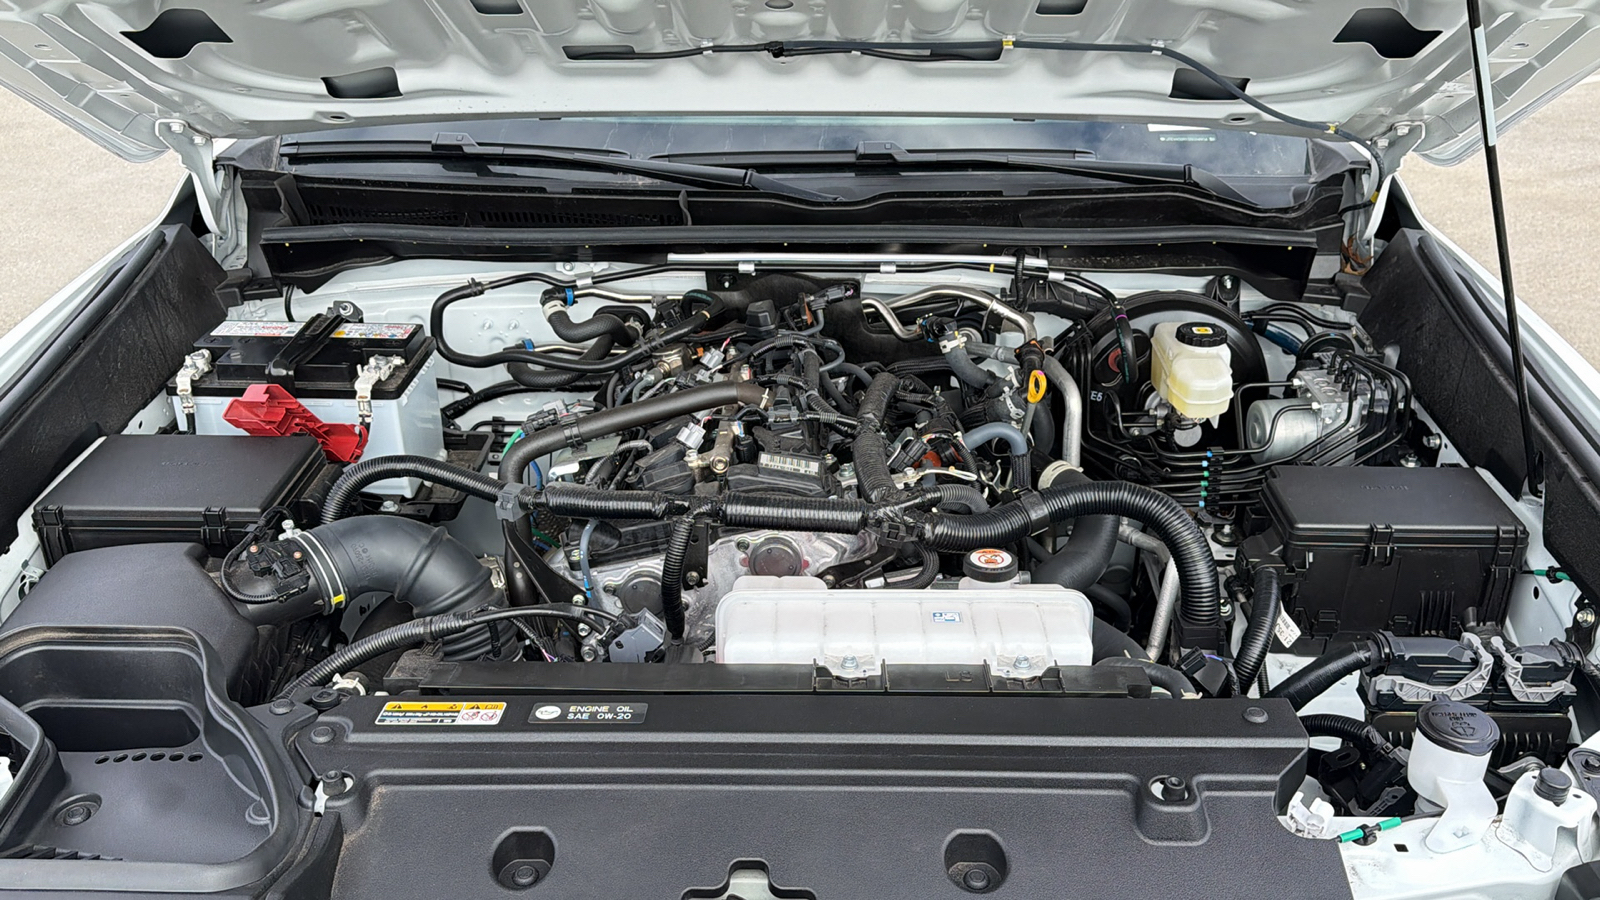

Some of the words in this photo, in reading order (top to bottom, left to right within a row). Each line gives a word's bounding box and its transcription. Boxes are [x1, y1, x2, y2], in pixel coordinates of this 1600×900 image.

[569, 705, 610, 713] ENGINE
[616, 705, 634, 713] OIL
[566, 712, 591, 720] SAE
[596, 712, 632, 720] 0W-20
